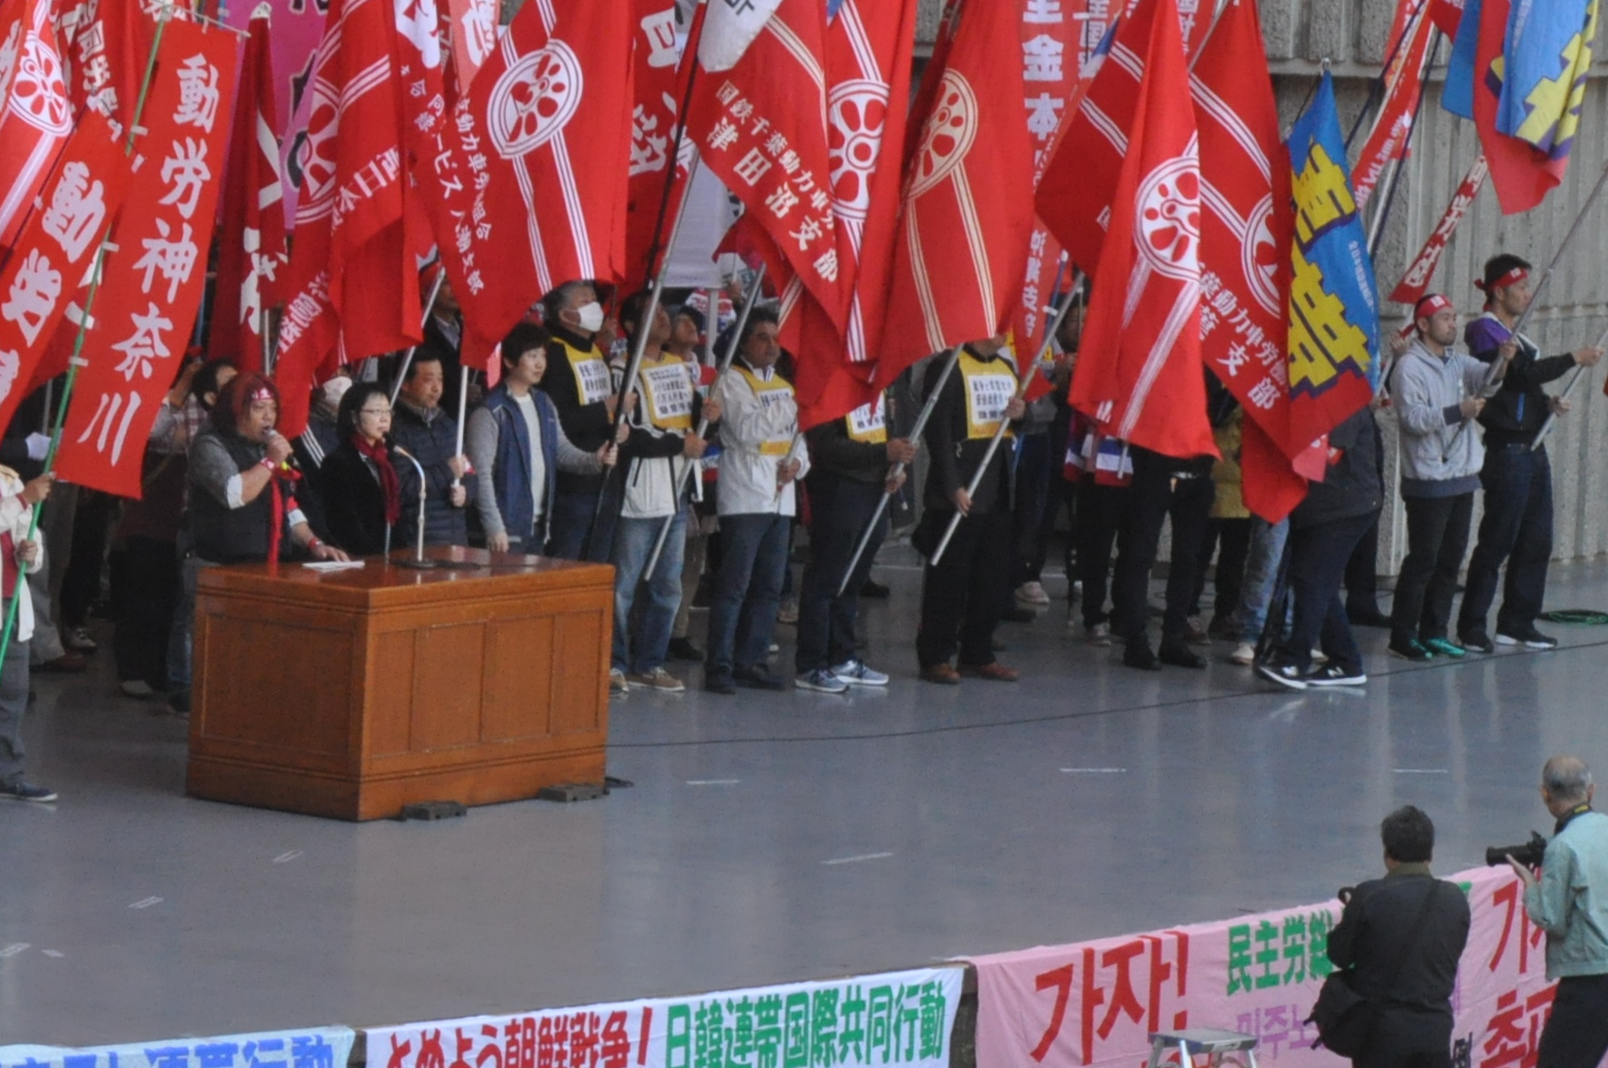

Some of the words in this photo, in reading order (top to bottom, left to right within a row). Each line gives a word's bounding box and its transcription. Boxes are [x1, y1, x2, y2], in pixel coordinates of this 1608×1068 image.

[77, 52, 219, 468] 動労神奈川
[707, 116, 838, 284] 津田沼支部
[666, 980, 946, 1068] 日韓連帯国際共同行動
[1029, 930, 1189, 1066] 가자!
